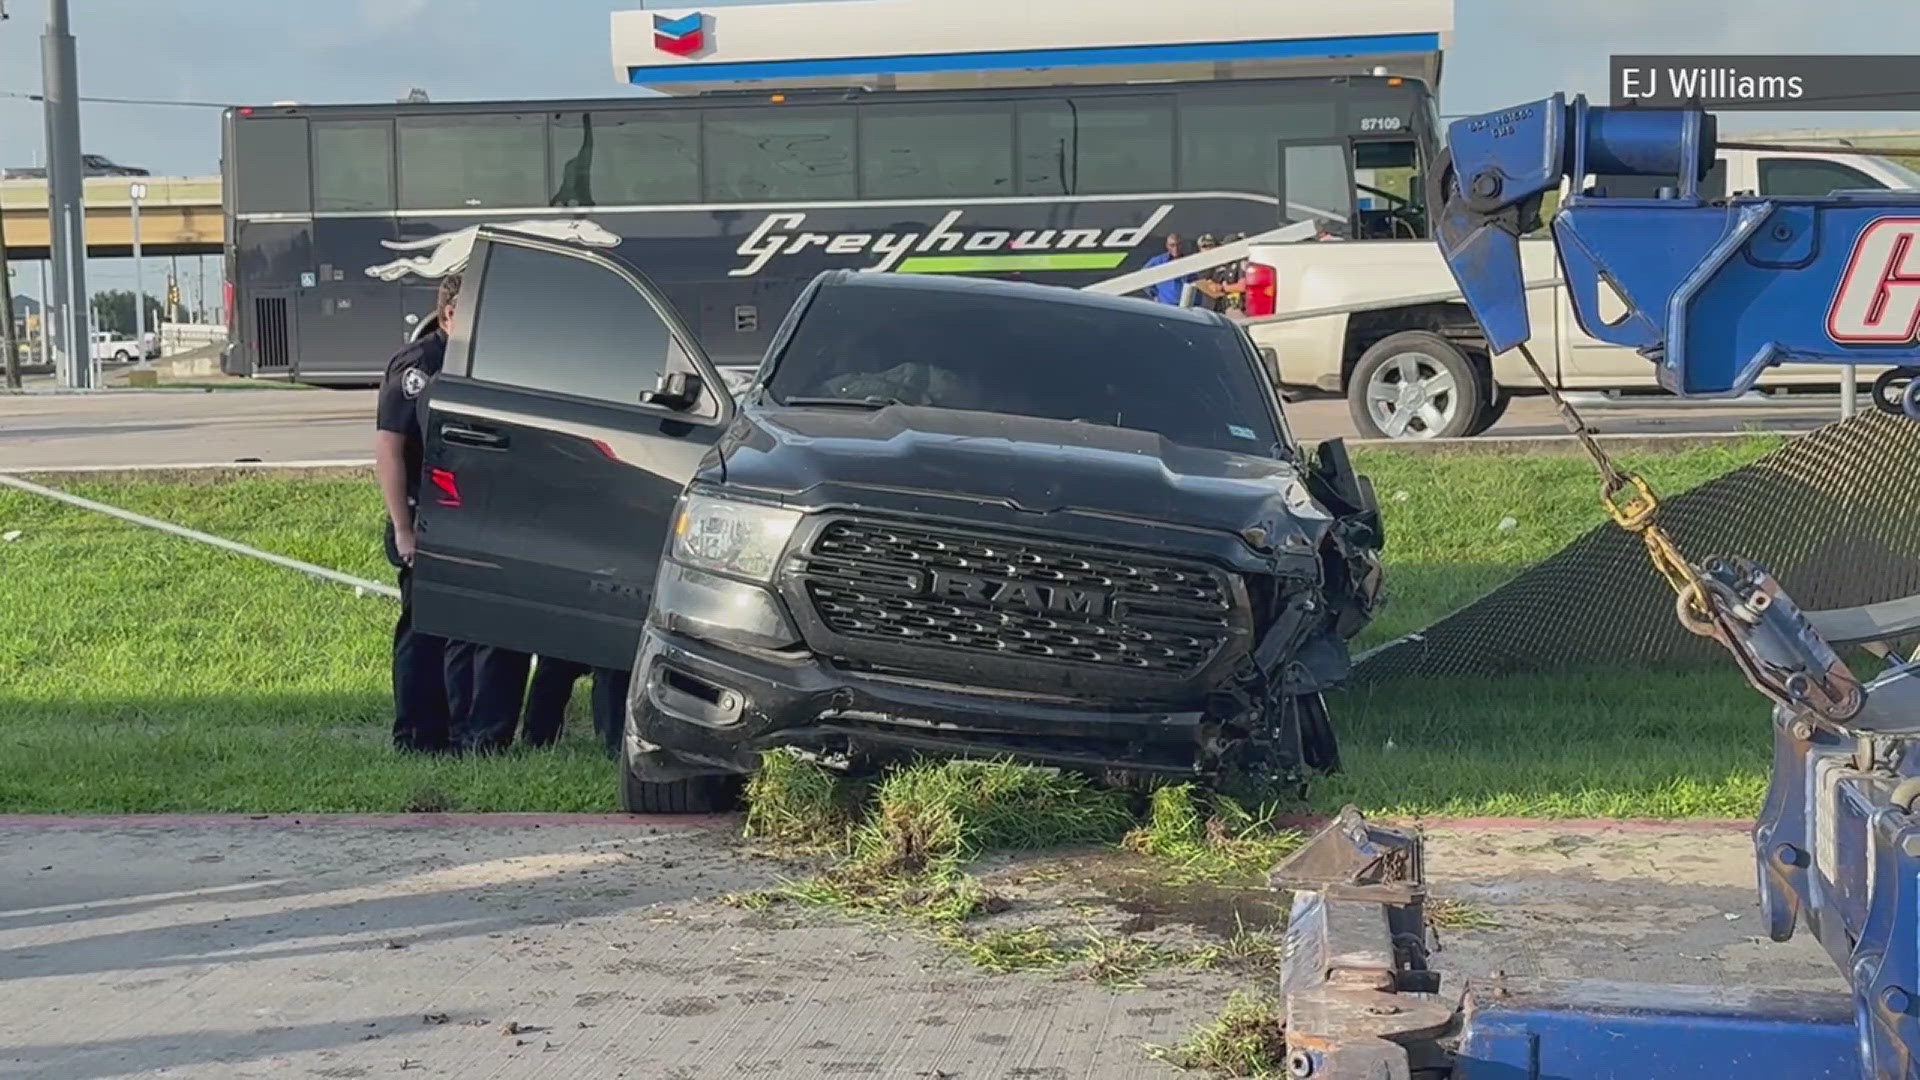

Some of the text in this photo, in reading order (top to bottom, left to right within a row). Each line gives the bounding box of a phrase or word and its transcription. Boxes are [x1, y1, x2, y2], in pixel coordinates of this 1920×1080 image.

[1361, 117, 1400, 130] 87109
[728, 204, 1174, 276] Greyhound
[931, 569, 1108, 616] RAM
